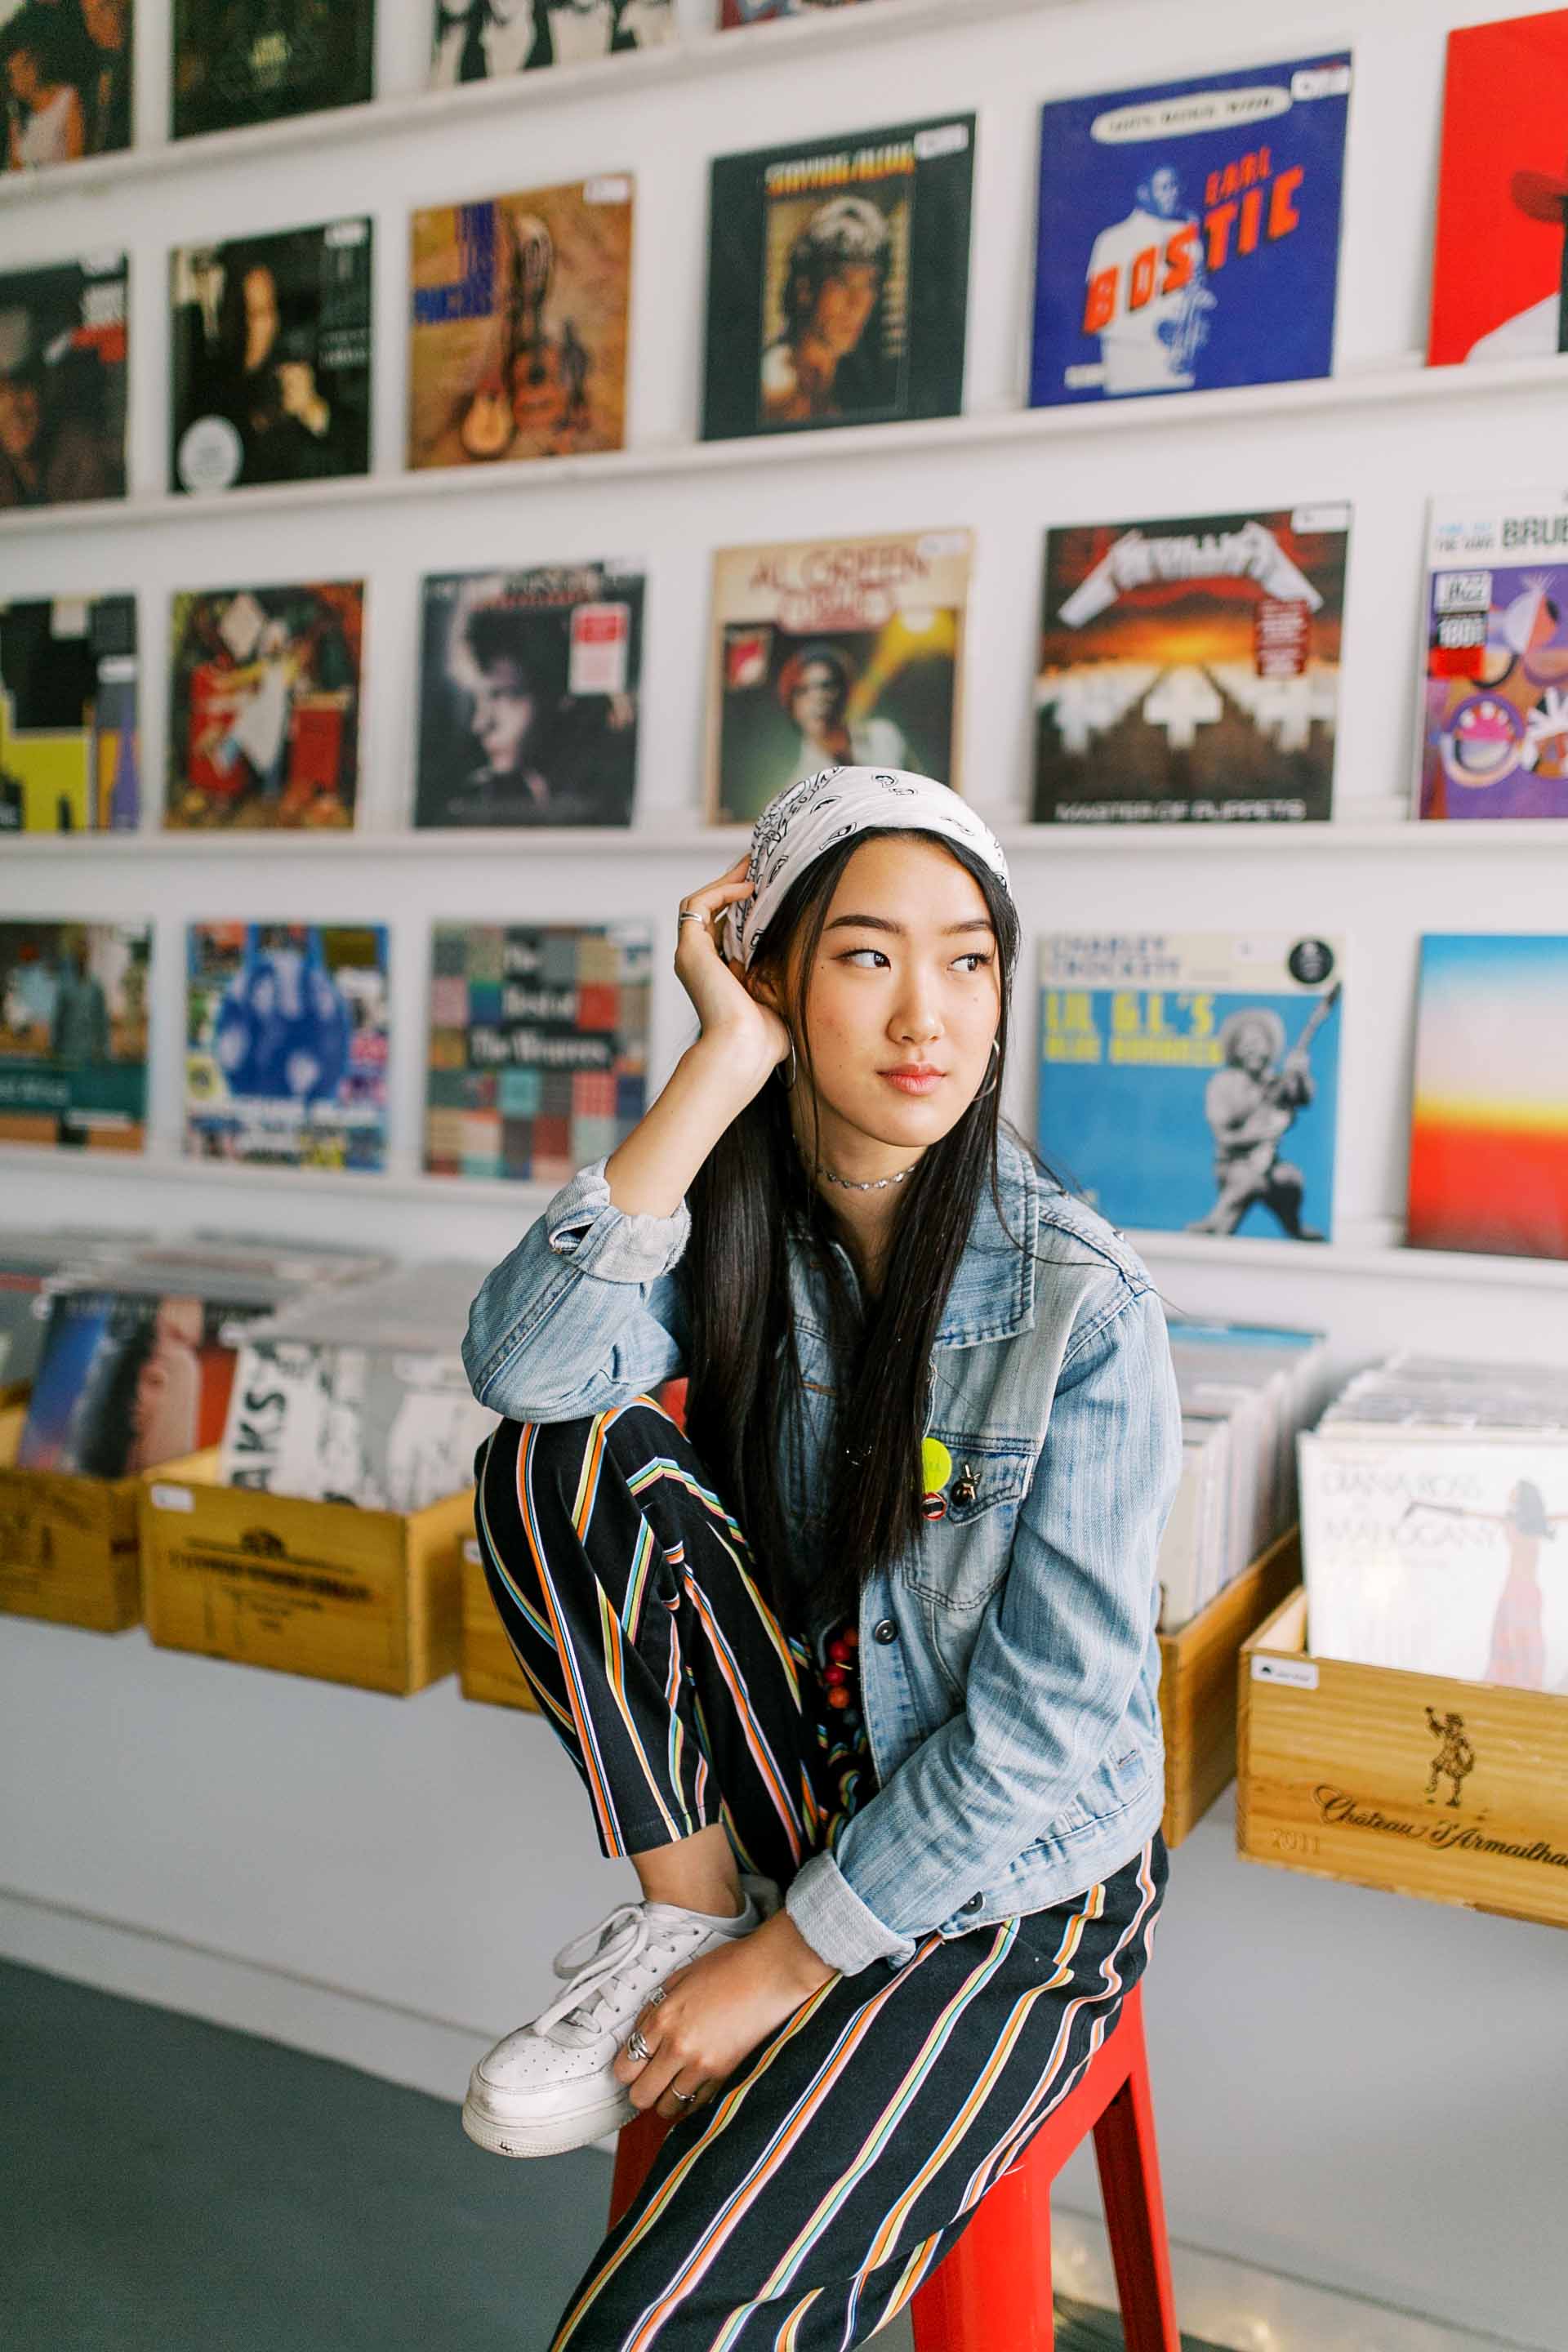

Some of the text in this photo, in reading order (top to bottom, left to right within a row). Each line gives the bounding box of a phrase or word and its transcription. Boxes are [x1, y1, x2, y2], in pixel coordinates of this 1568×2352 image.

[1205, 145, 1272, 206] EARL
[1080, 165, 1304, 336] BOSTIC
[1191, 798, 1307, 822] PUPPETS
[1271, 1827, 1321, 1856] 2011
[1312, 1784, 1568, 1869] Château d'Armailha
